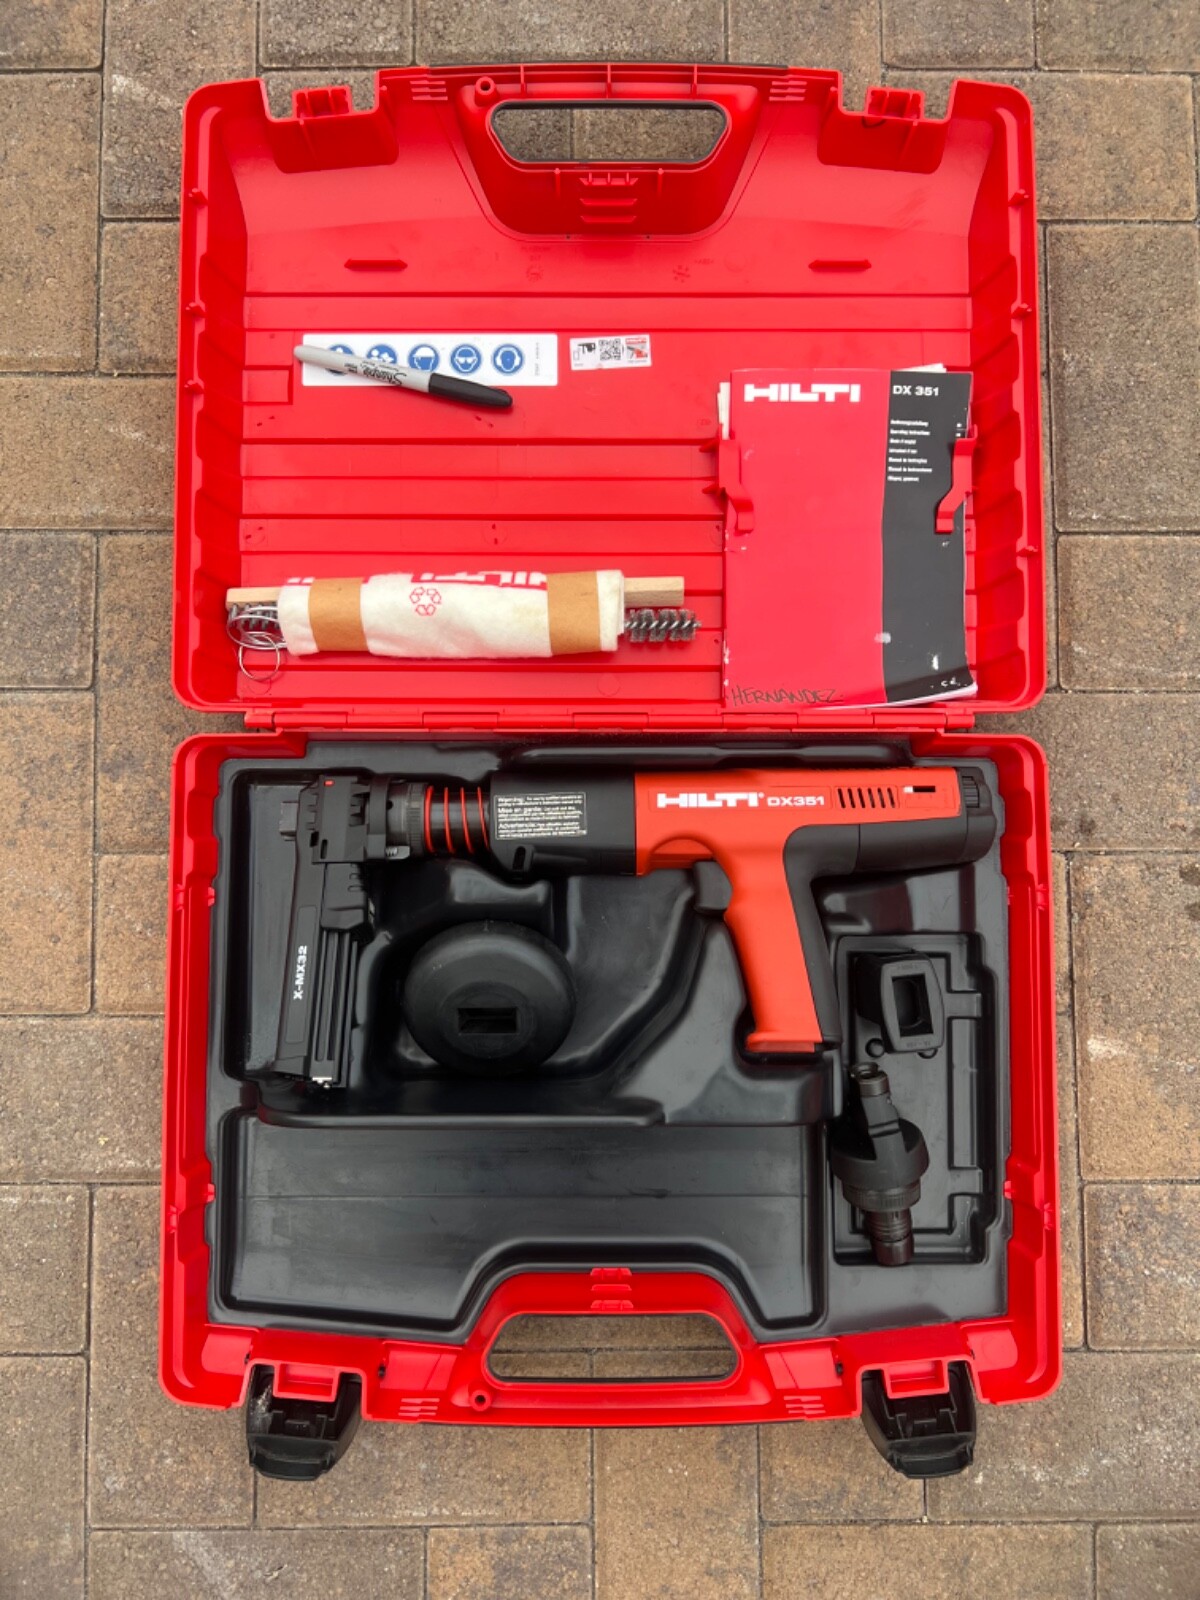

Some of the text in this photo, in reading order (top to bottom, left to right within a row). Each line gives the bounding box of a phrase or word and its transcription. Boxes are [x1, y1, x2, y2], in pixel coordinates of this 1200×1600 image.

[743, 383, 861, 403] HILTI
[892, 384, 940, 397] DX 351
[731, 684, 844, 707] HERNANDEZ
[656, 792, 826, 809] HILTI DX351
[292, 944, 308, 1000] X-MX32
